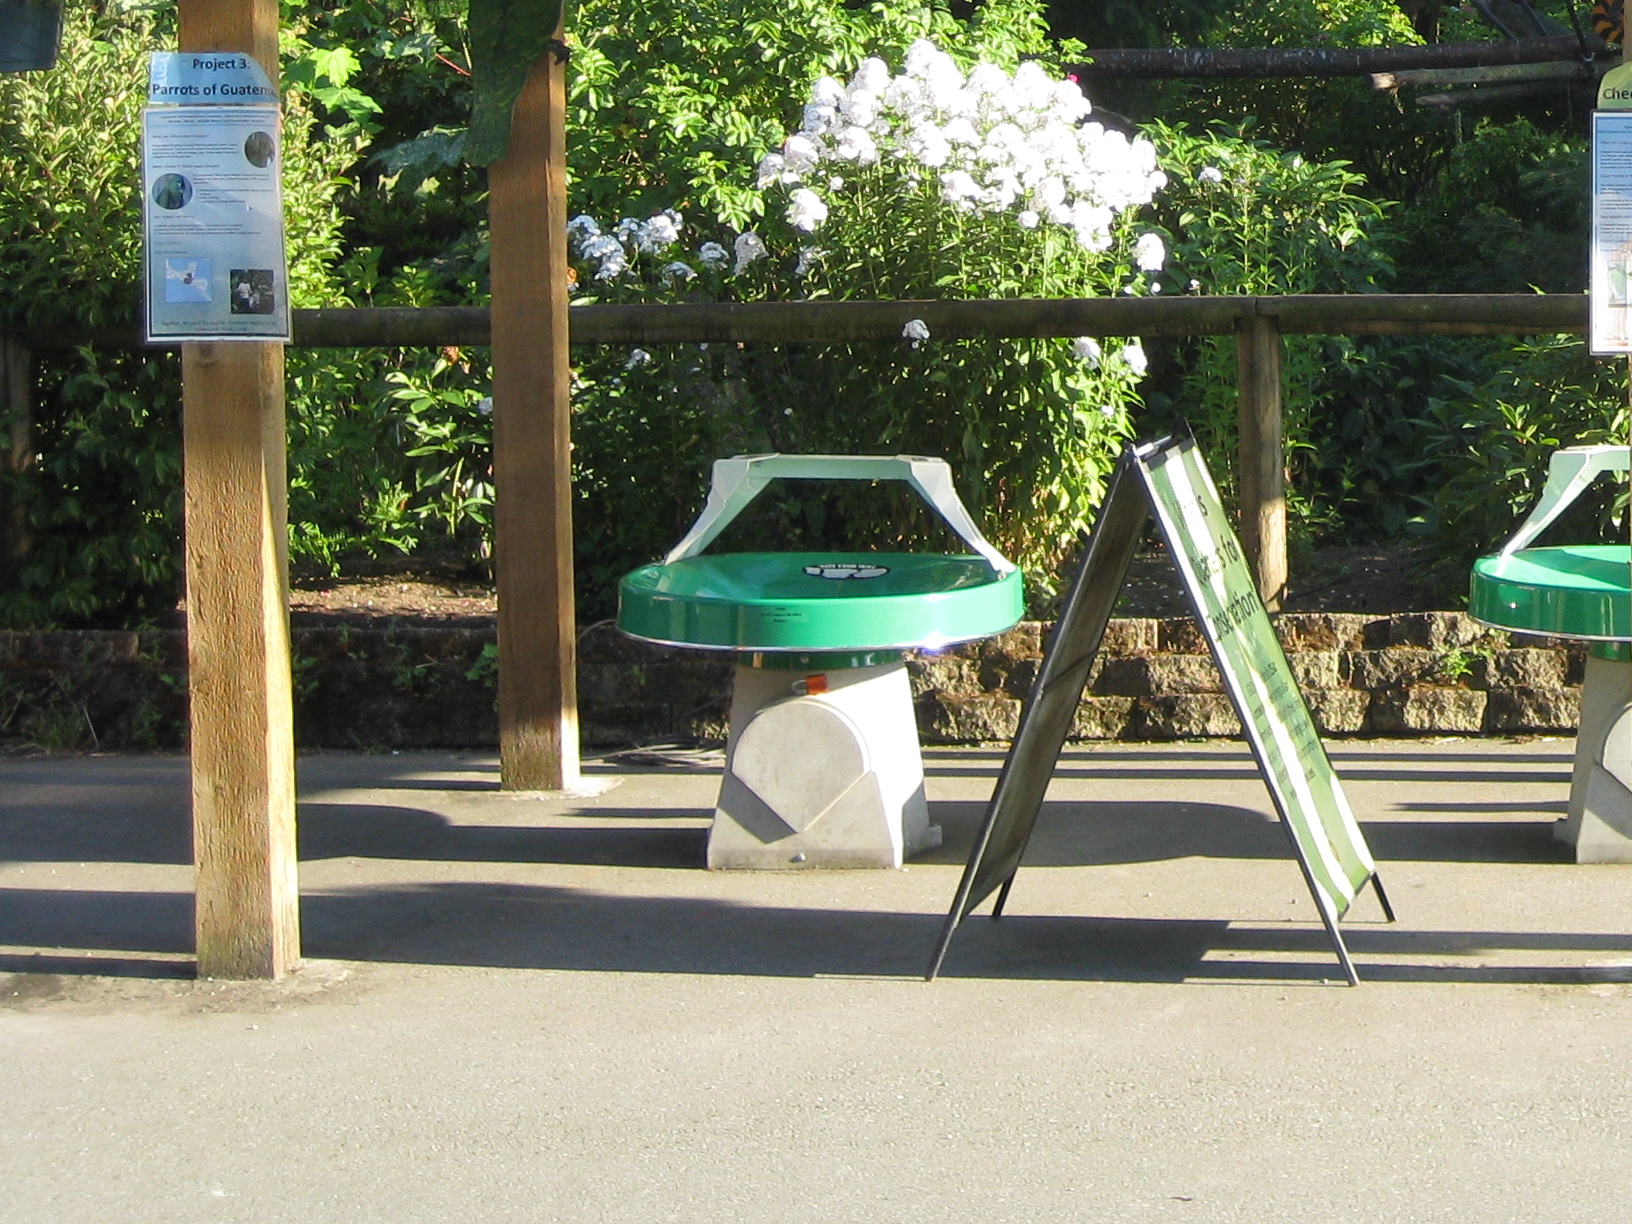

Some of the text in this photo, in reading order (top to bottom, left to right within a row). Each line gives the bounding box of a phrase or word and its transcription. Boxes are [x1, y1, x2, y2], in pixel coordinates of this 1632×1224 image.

[192, 58, 236, 72] Project
[153, 84, 200, 96] Parrots
[203, 83, 217, 95] of
